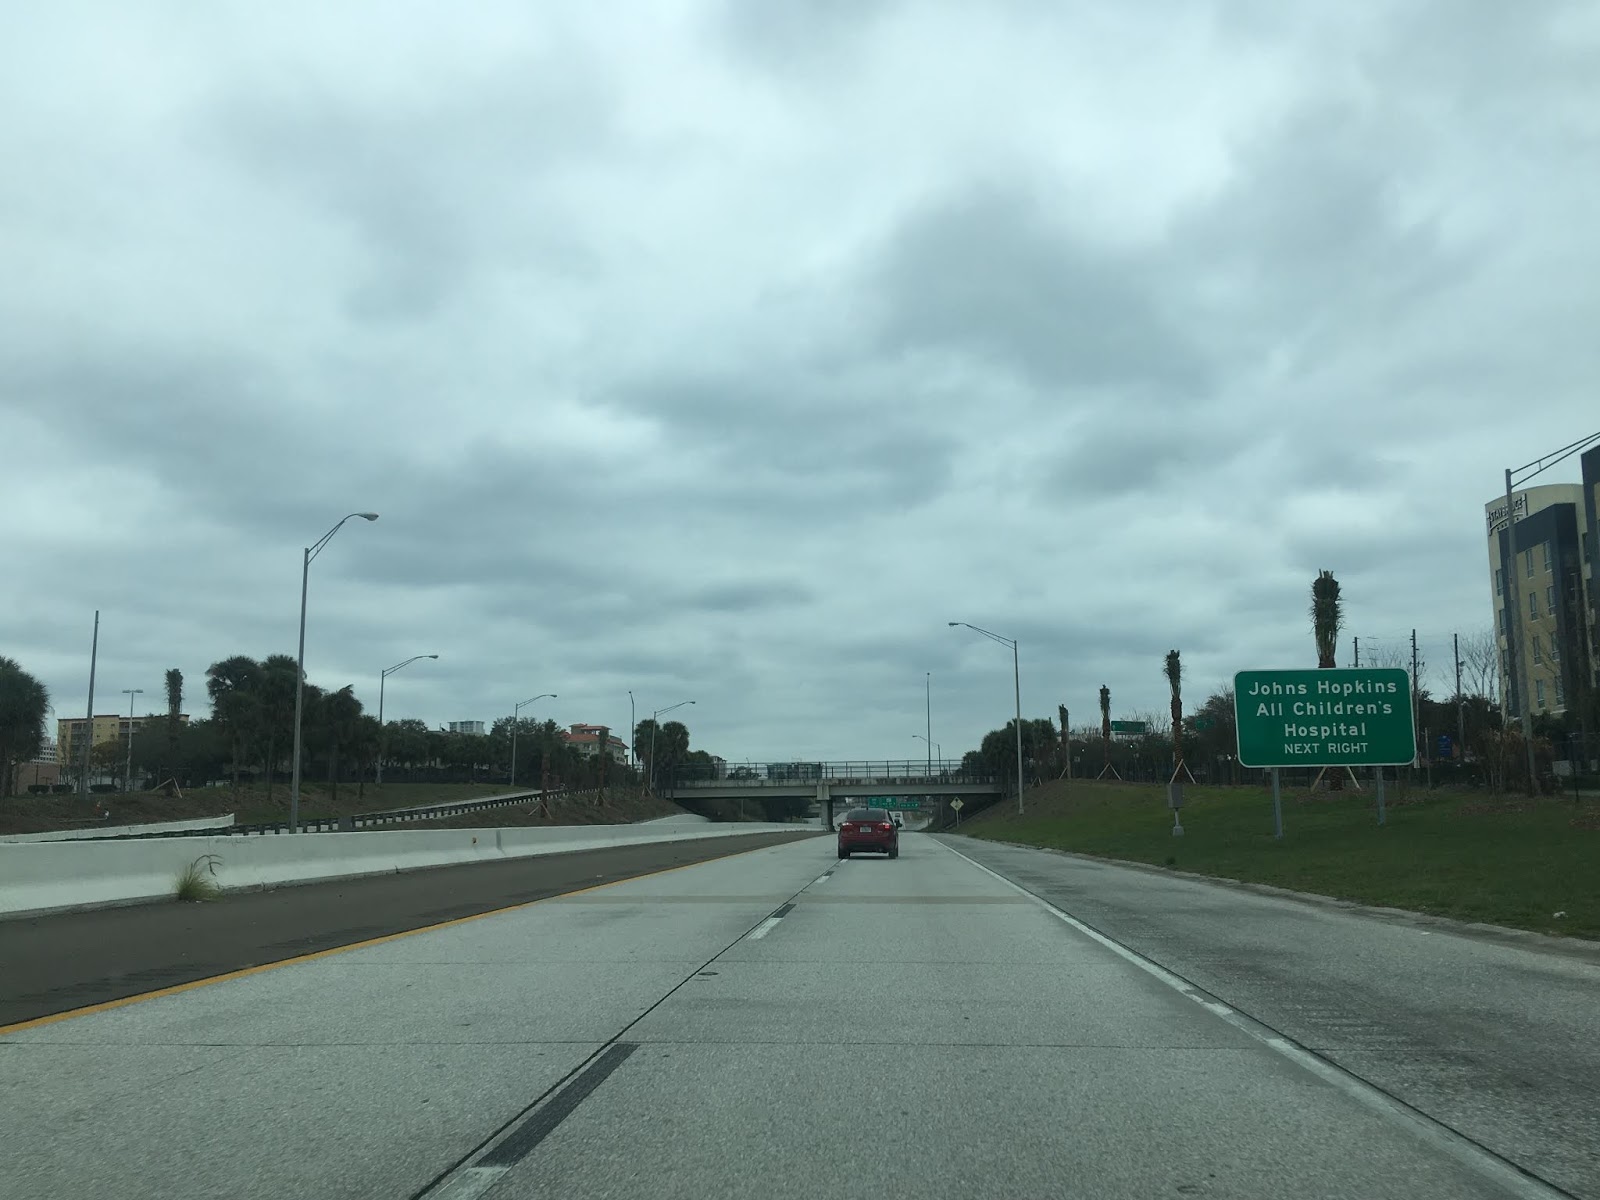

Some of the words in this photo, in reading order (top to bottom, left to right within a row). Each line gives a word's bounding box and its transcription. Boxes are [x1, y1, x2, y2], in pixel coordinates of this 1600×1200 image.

[1248, 681, 1308, 696] Johns
[1317, 679, 1397, 697] Hopkins
[1256, 702, 1283, 717] All
[1293, 700, 1393, 716] Children's
[1284, 722, 1366, 740] Hospital
[1284, 743, 1320, 754] NEXT
[1328, 742, 1369, 754] RIGHT
